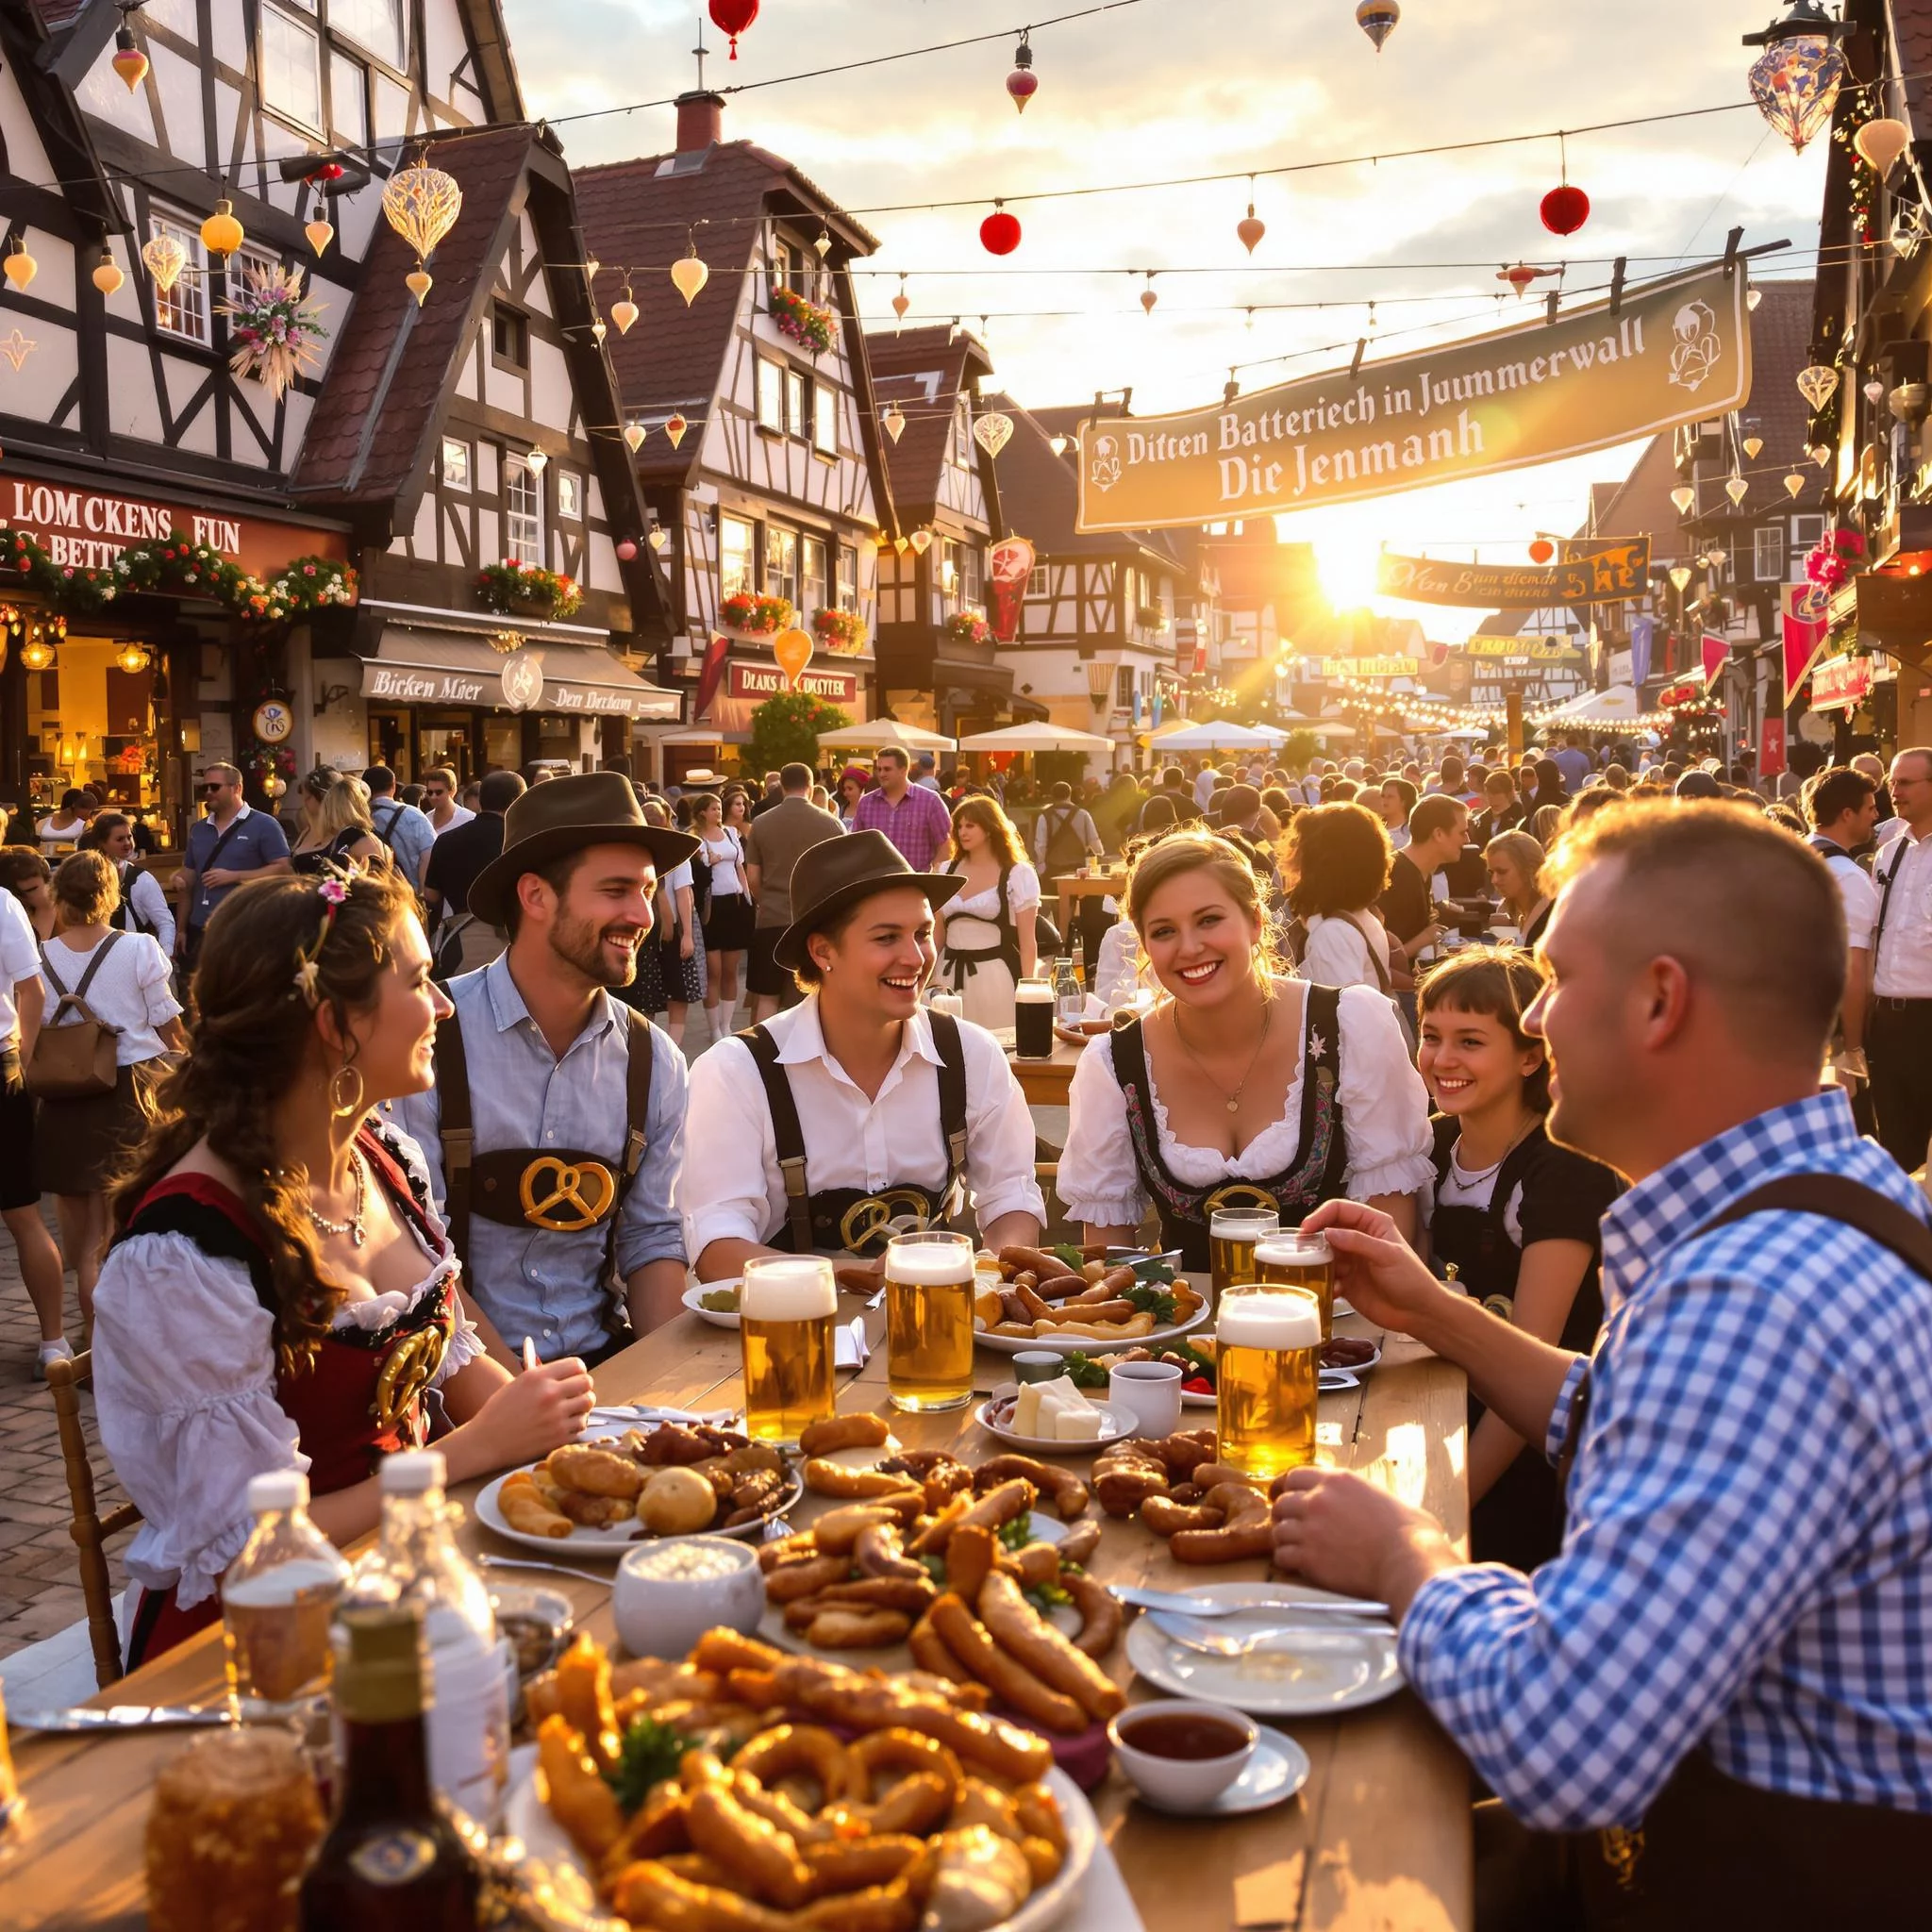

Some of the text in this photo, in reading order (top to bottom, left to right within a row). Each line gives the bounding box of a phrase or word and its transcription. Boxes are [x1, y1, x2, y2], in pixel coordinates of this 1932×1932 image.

[1384, 385, 1412, 416] in
[1292, 408, 1485, 497] Jenmanh
[192, 515, 241, 555] FUN
